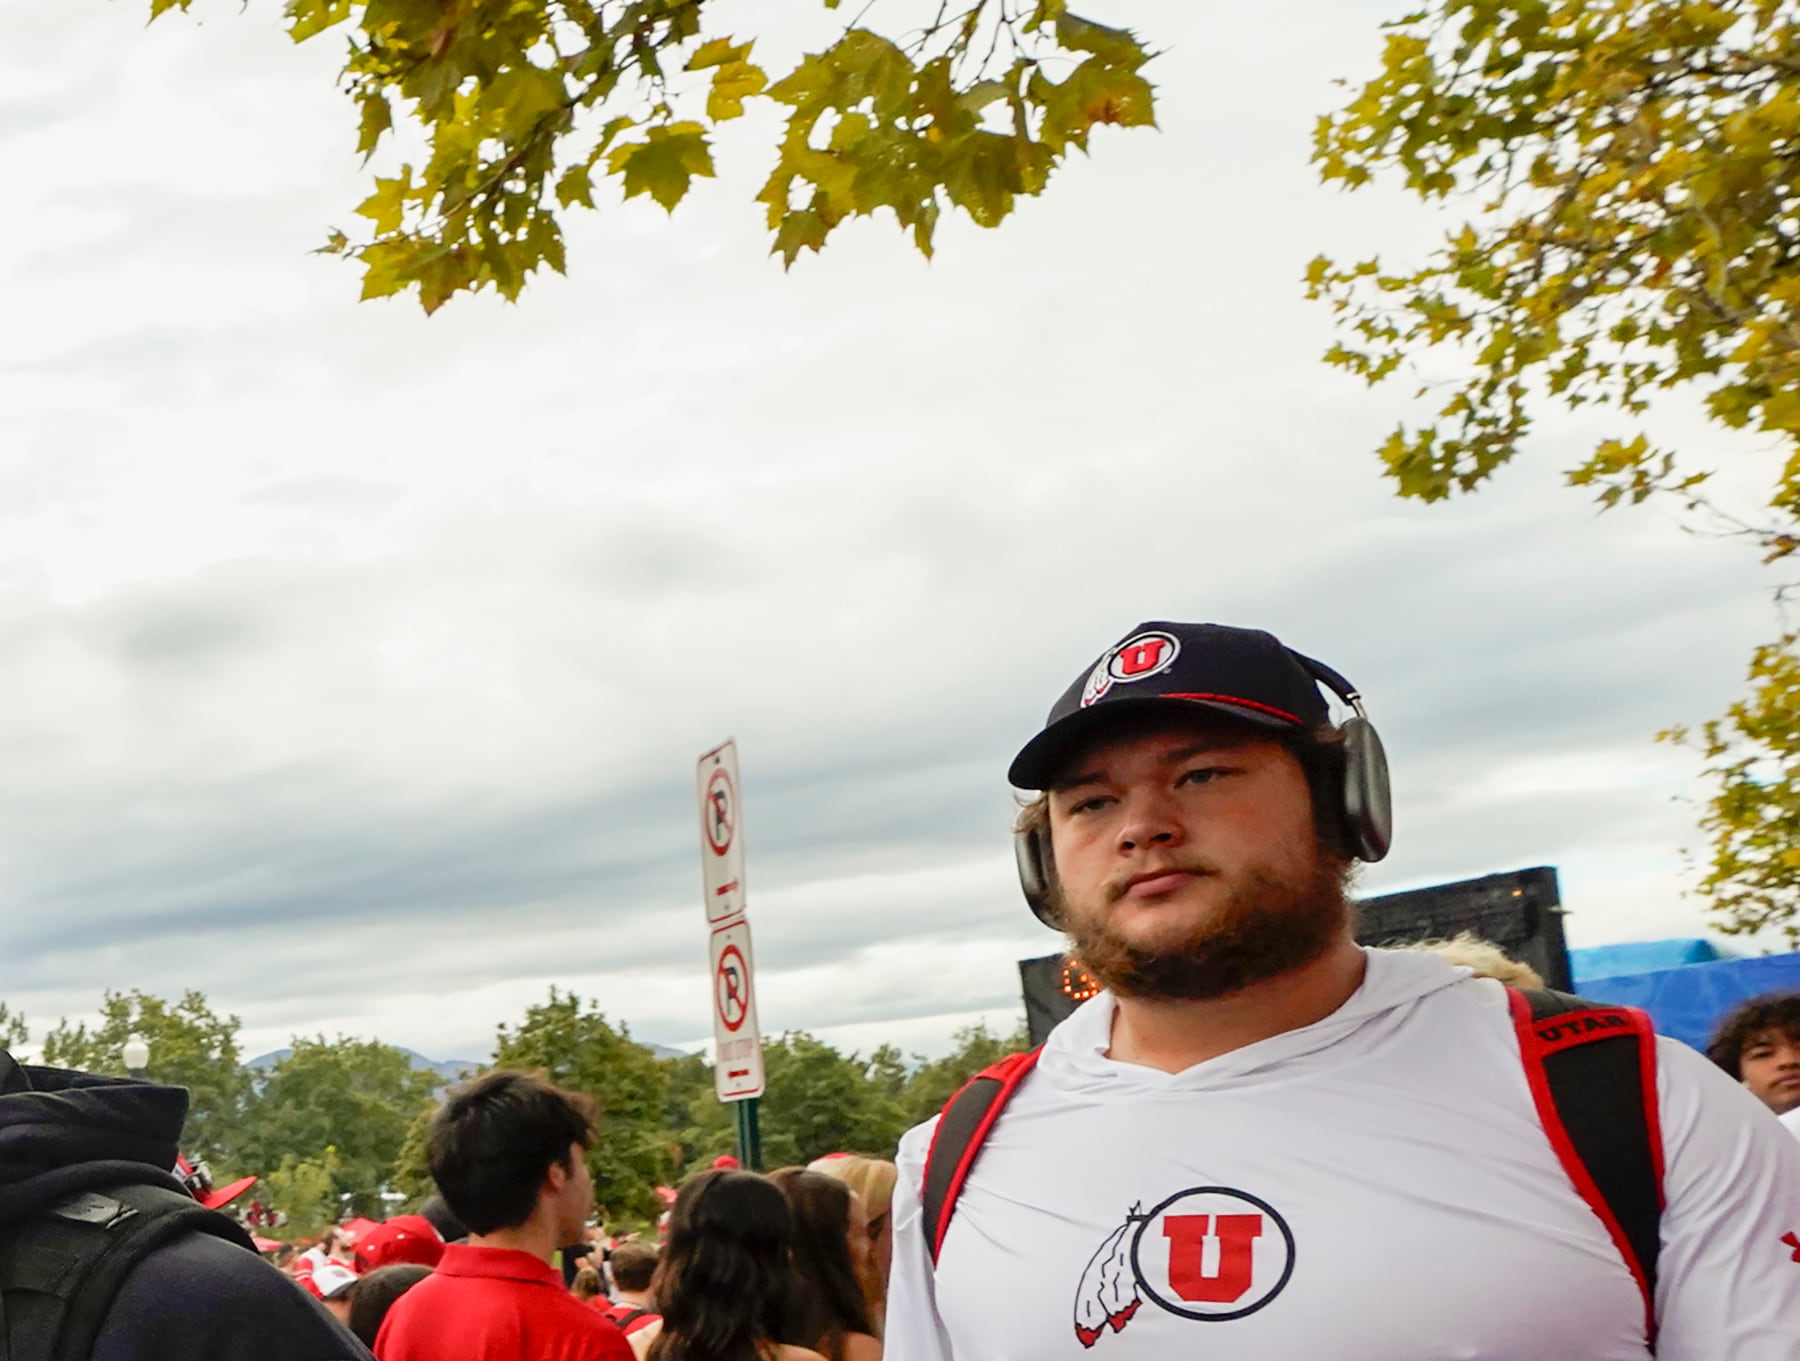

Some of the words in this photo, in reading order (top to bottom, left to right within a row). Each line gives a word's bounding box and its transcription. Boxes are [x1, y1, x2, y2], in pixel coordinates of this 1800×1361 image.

[1119, 639, 1167, 676] U
[1537, 1015, 1628, 1041] UTAH
[1162, 1213, 1264, 1304] U
